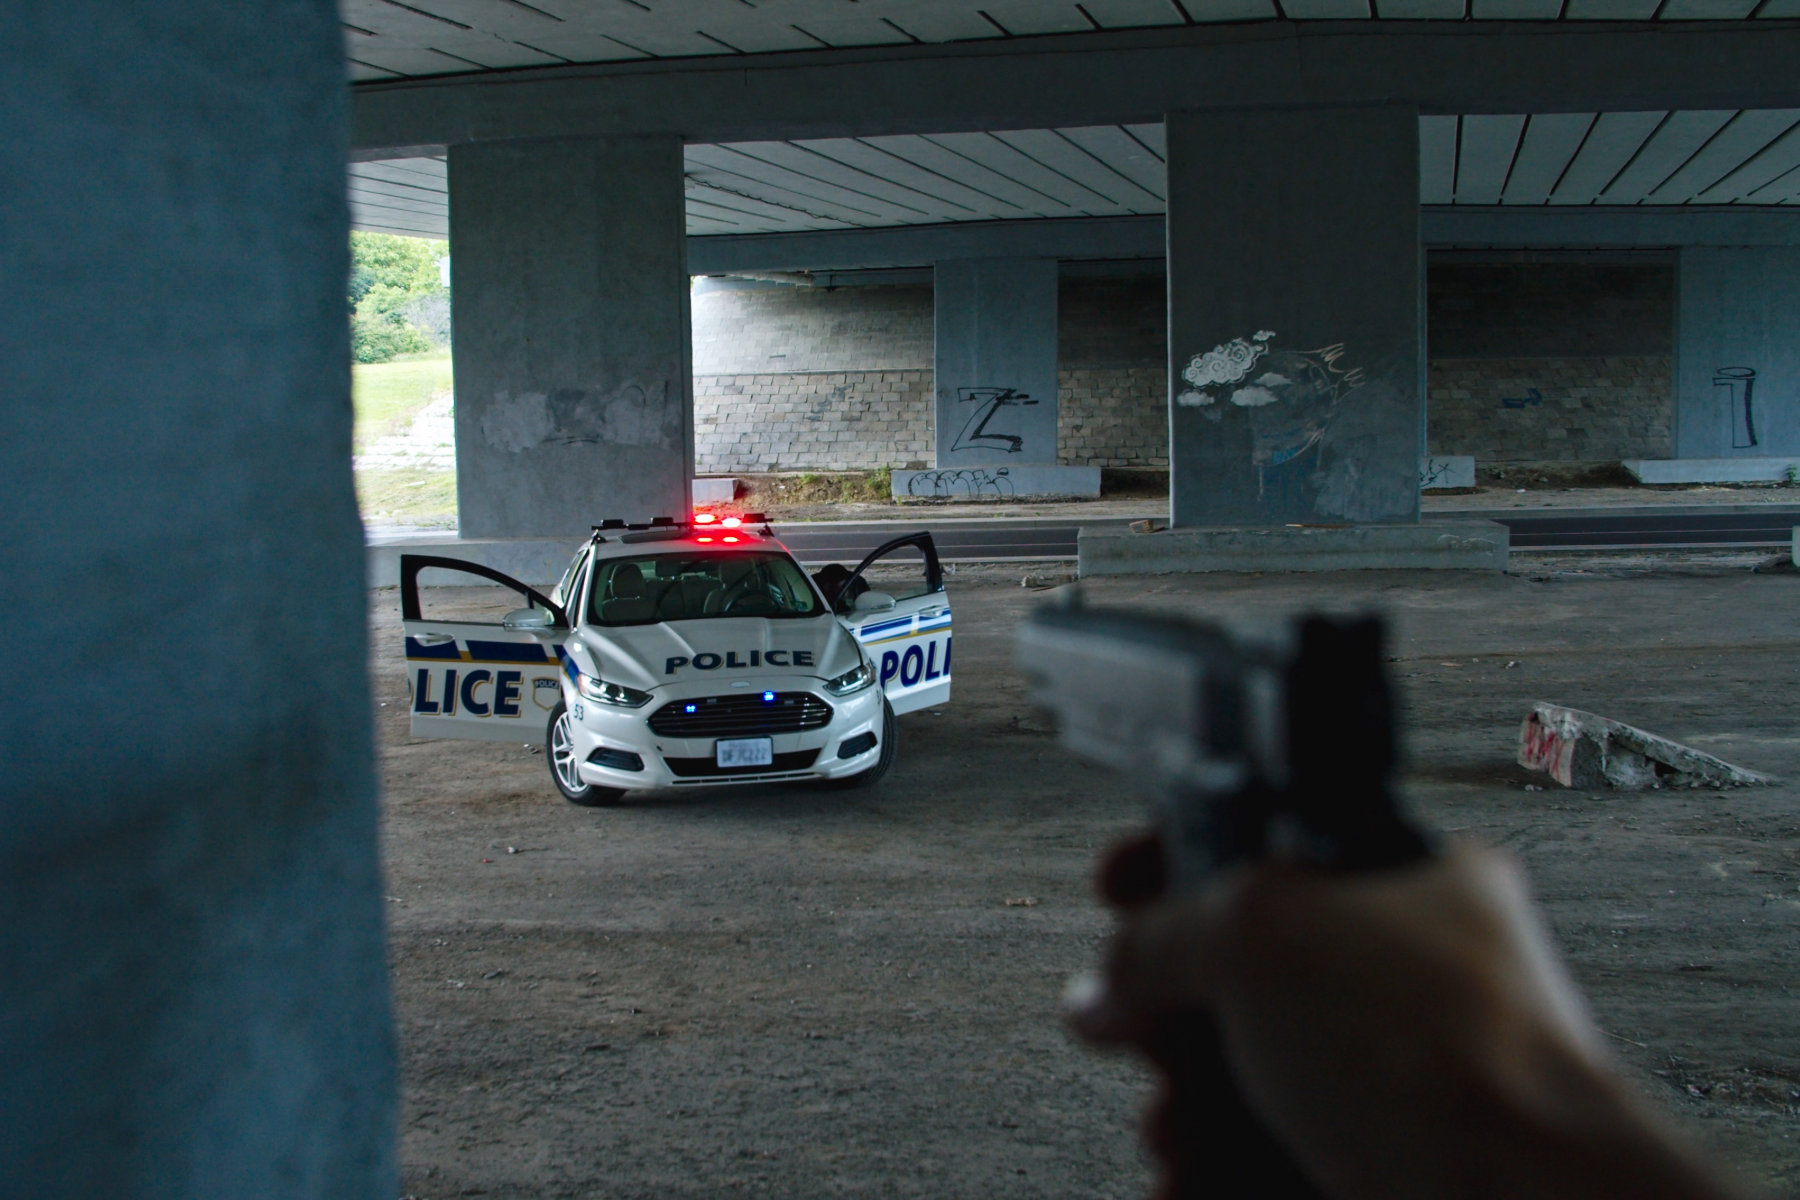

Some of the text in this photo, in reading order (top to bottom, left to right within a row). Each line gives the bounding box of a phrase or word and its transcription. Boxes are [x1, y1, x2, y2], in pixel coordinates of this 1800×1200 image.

[665, 650, 816, 675] POLICE
[407, 668, 525, 718] LICE
[535, 680, 559, 688] POLICE
[574, 703, 584, 721] 53
